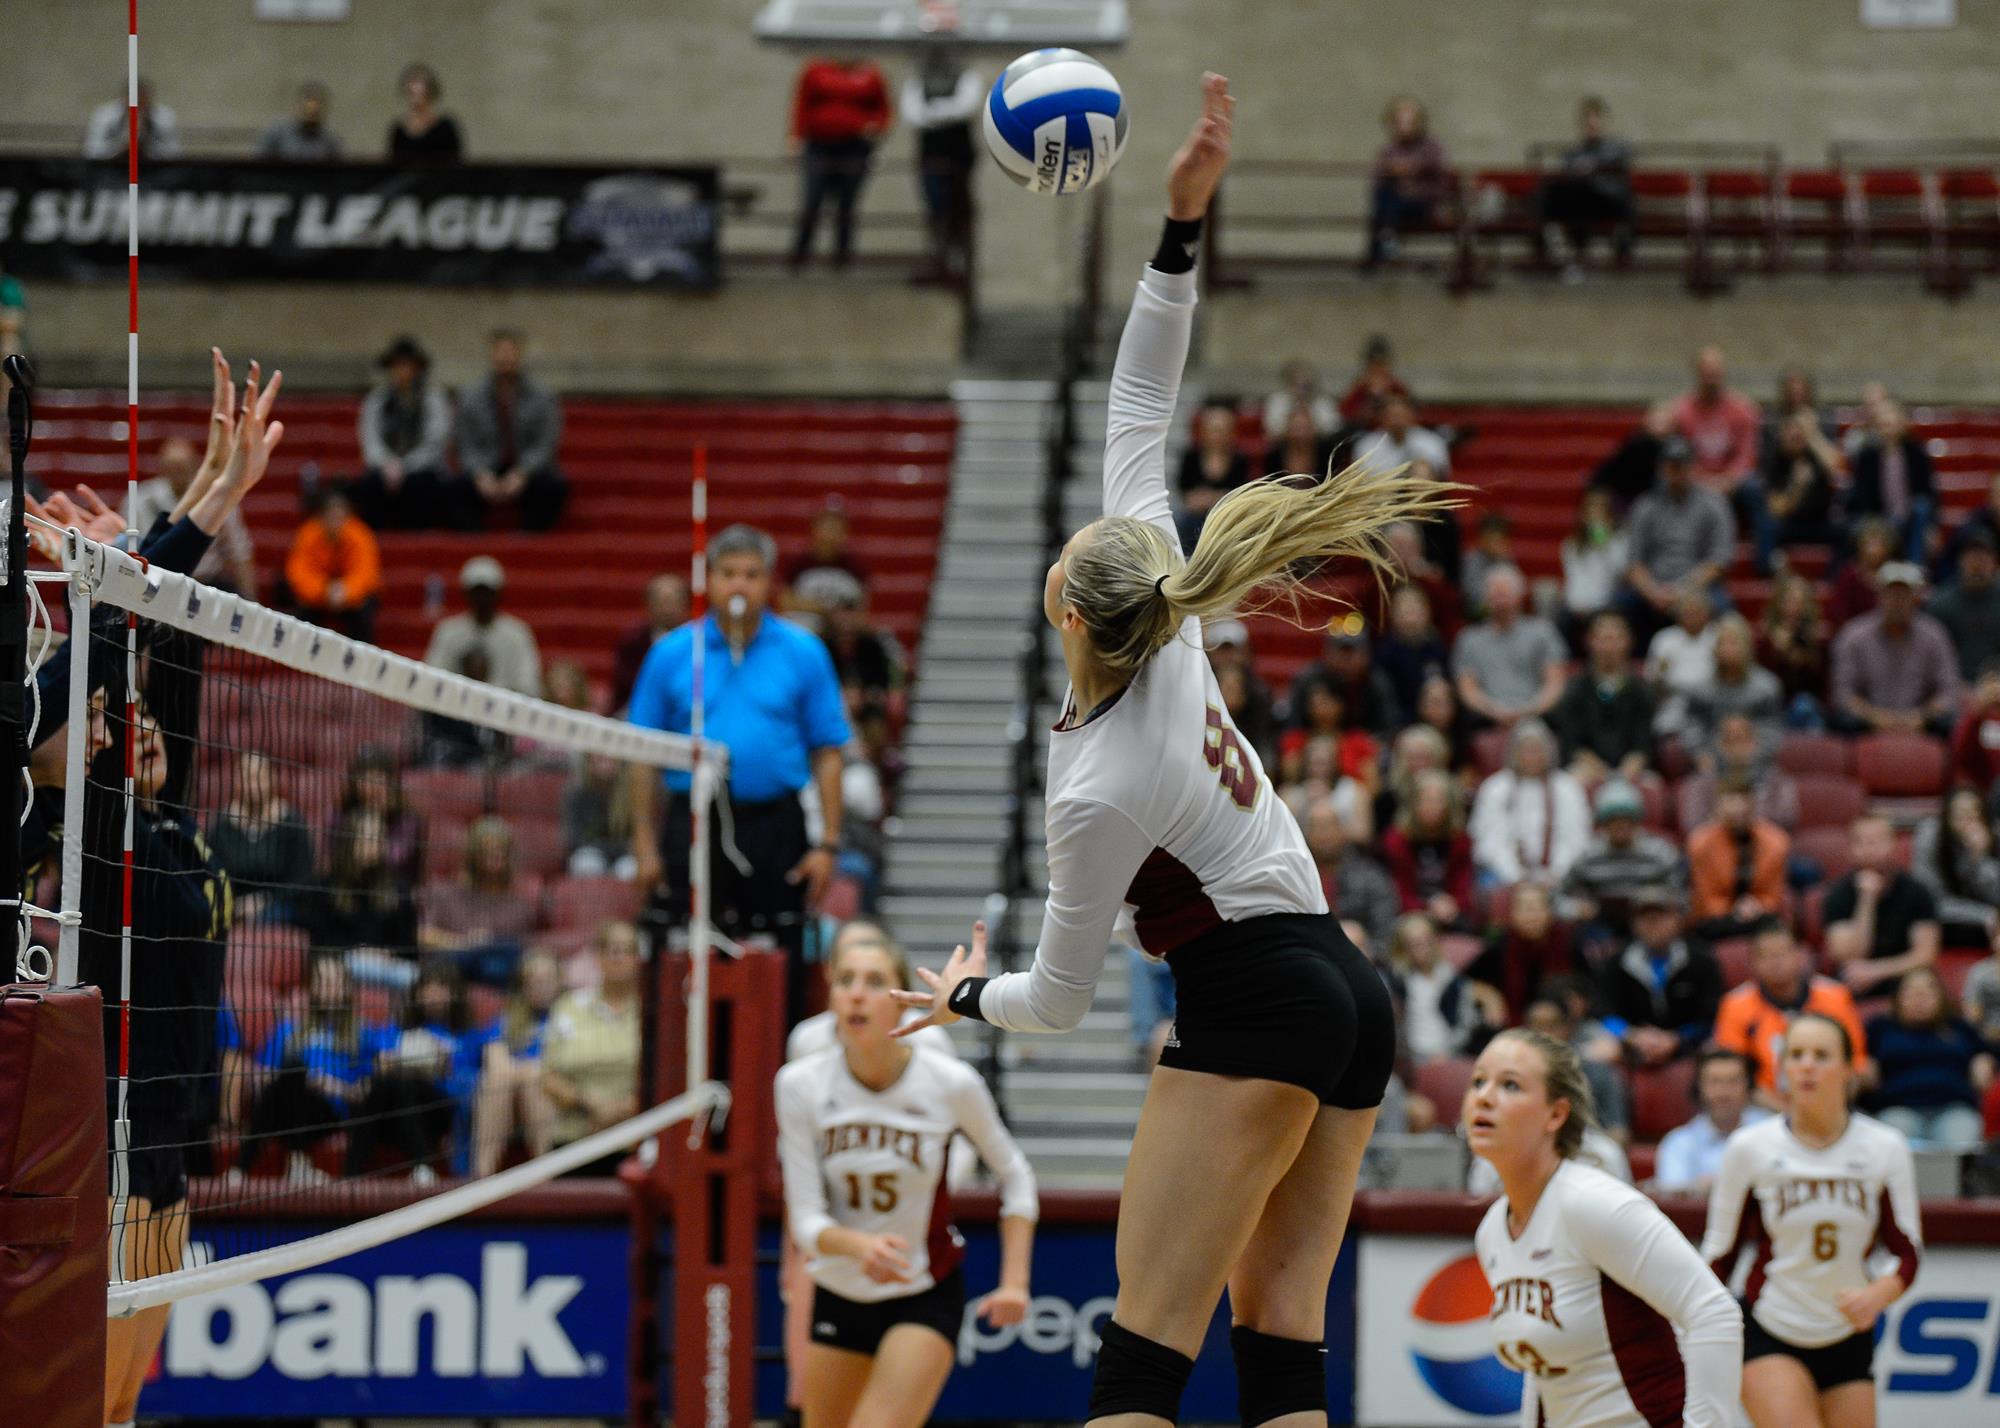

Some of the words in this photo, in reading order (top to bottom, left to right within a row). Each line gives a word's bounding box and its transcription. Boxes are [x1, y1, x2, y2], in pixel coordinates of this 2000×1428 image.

[24, 189, 291, 246] SUMMIT
[295, 194, 568, 251] LEAGUE
[822, 1122, 925, 1171] DENVER
[845, 1171, 899, 1212] 15
[1812, 1221, 1839, 1262] 6
[165, 1240, 586, 1380] bank
